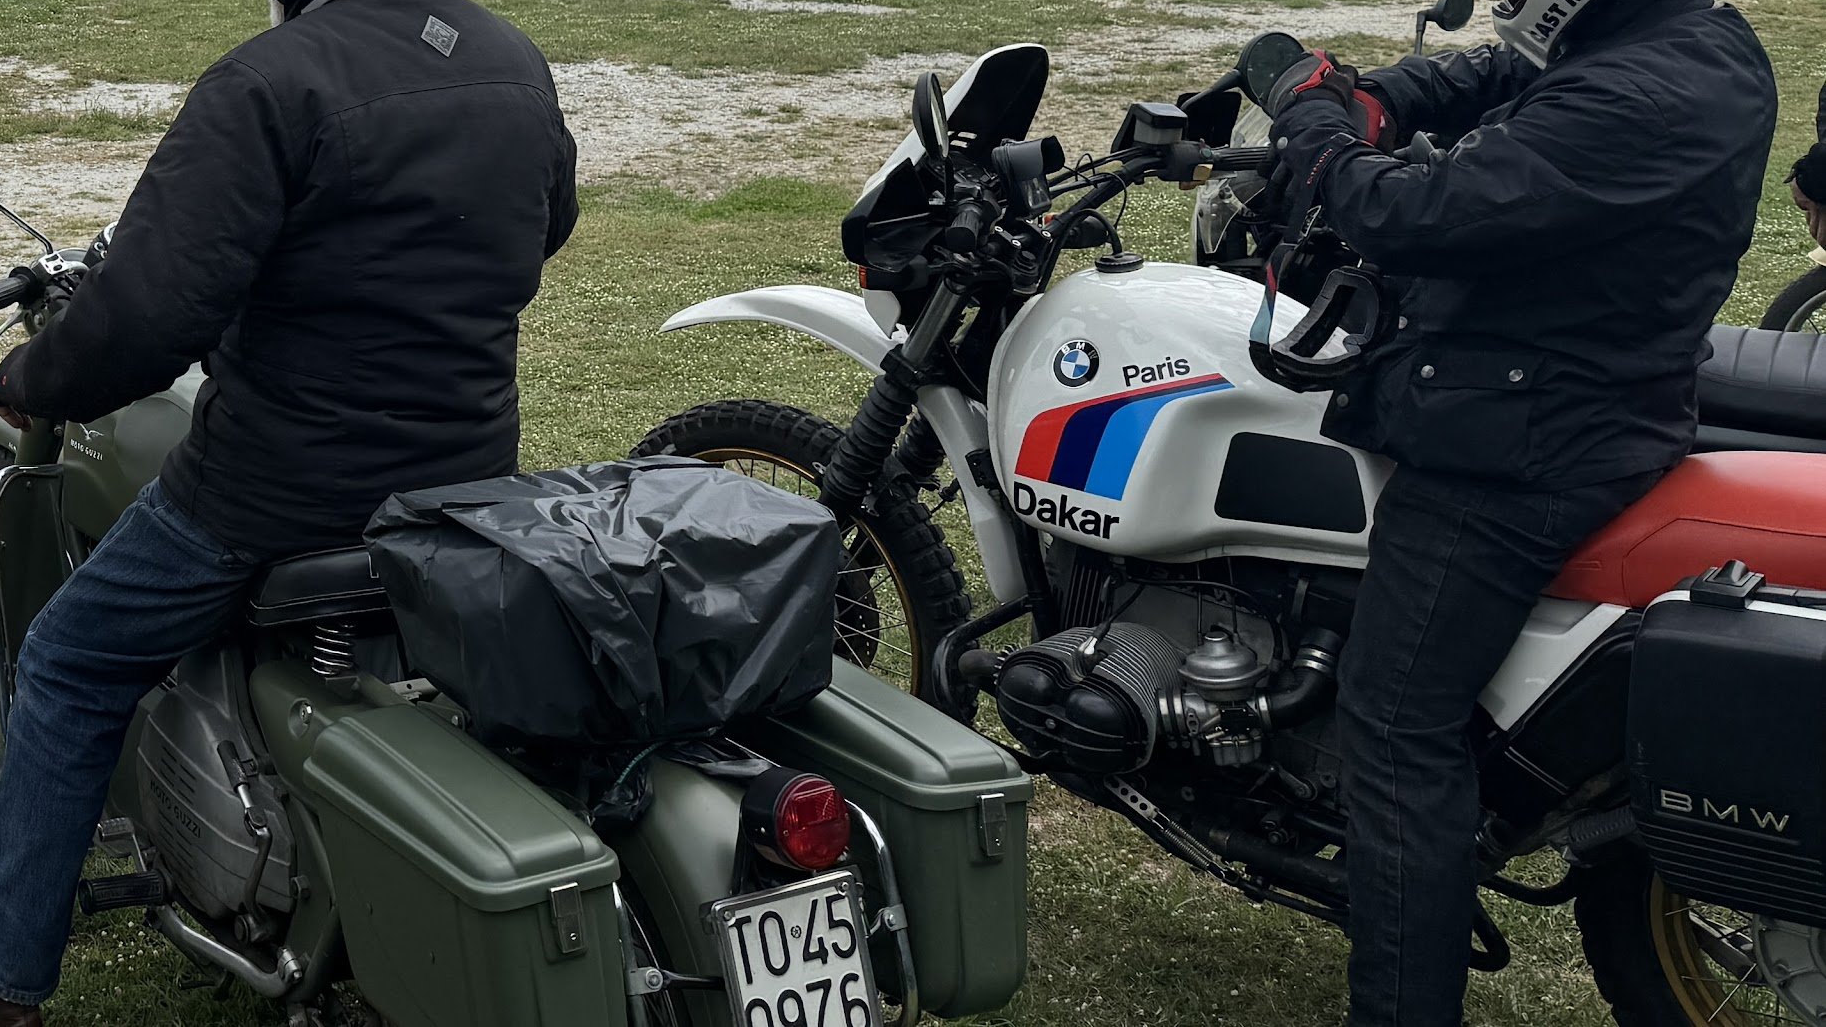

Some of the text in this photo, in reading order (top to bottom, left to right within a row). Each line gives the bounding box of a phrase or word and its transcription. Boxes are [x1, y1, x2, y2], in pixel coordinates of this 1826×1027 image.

[1061, 342, 1098, 360] BMW
[1123, 356, 1191, 387] Paris
[1013, 482, 1120, 540] Dakar
[1660, 789, 1790, 833] BMW
[728, 894, 857, 984] TO 45
